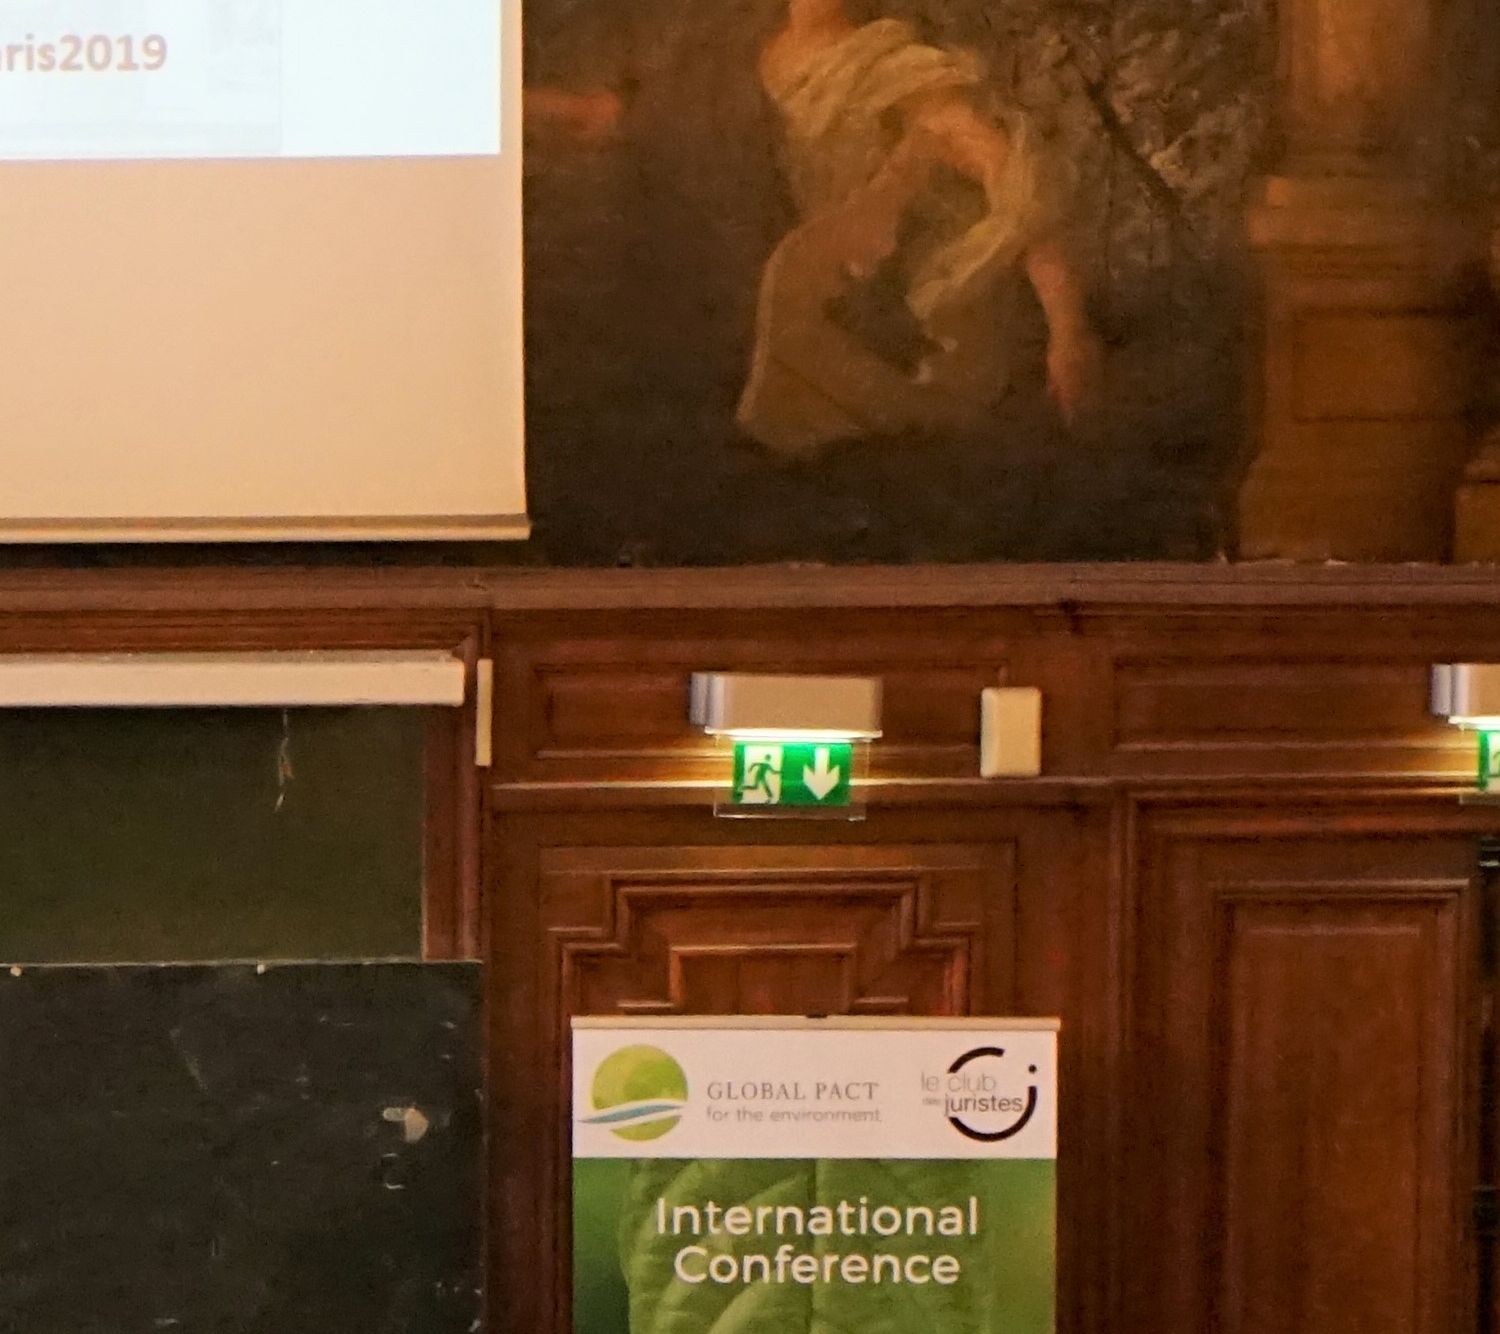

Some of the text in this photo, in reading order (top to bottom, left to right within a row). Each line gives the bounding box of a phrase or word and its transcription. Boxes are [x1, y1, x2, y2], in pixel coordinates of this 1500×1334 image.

[706, 1081, 879, 1101] GLOBAL PACT
[920, 1071, 997, 1093] le club
[706, 1105, 883, 1124] for the environment
[944, 1094, 1024, 1117] juristes
[656, 1196, 978, 1237] International
[674, 1244, 961, 1285] Conference
